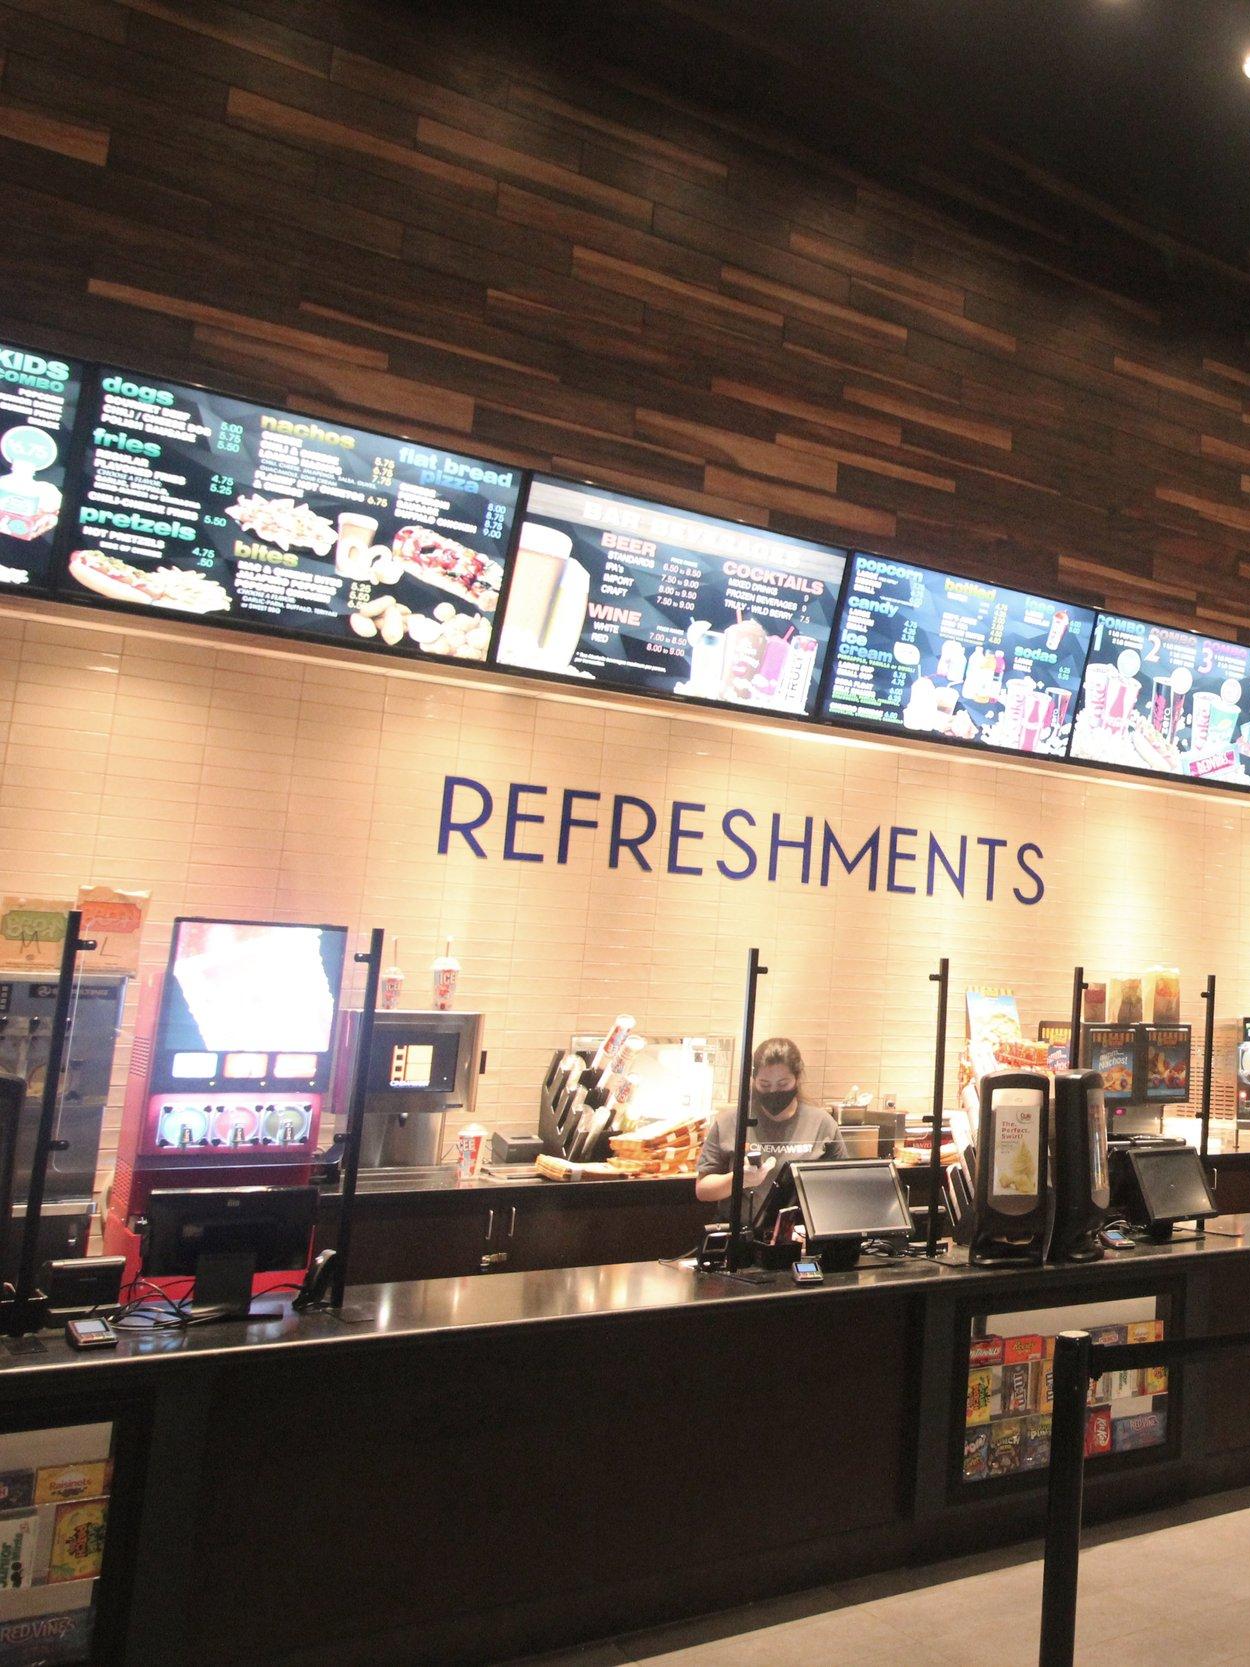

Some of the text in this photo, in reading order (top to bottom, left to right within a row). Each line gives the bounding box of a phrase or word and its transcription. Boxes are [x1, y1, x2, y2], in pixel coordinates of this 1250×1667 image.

[0, 349, 69, 381] KIDS
[102, 376, 174, 405] dogs
[260, 415, 356, 449] nachos
[93, 427, 161, 457] fries
[399, 446, 513, 488] flat bread
[210, 484, 232, 495] 5.25
[211, 475, 234, 486] 4.75
[419, 469, 480, 494] pizza
[367, 496, 388, 507] 6.75
[487, 503, 507, 515] 8.00
[79, 506, 196, 541] pretzels
[204, 515, 227, 527] 5.50
[485, 511, 505, 523] 8.75
[582, 500, 641, 530] BAR
[482, 528, 501, 539] 9.00
[484, 520, 503, 531] 8.75
[192, 547, 215, 559] 4.75
[234, 540, 299, 567] bites
[601, 531, 657, 558] BEER
[605, 562, 625, 574] IPA's
[607, 550, 656, 569] STANDARDS
[662, 563, 679, 573] 6.50
[685, 568, 702, 578] 8.50
[722, 560, 825, 595] COCKTAILS
[855, 557, 924, 583] popcorn
[603, 573, 635, 587] IMPORT
[661, 574, 677, 584] 7.50
[683, 579, 700, 589] 9.00
[728, 577, 779, 596] MIXED DRINKS
[600, 584, 628, 597] CRAFT
[658, 585, 675, 595] 8.00
[681, 590, 697, 600] 9.50
[725, 588, 798, 611] FROZEN BEVERAGES
[656, 596, 672, 606] 7.50
[679, 600, 695, 611] 9.00
[724, 598, 794, 621] TRULY WILD BERRY
[848, 596, 899, 617] candy
[588, 602, 642, 627] WINE
[593, 621, 620, 634] WHITE
[1097, 614, 1146, 635] COMBO
[590, 632, 609, 643] RED
[649, 632, 665, 642] 7.00
[671, 636, 688, 646] 8.50
[841, 629, 868, 647] ice
[1094, 623, 1104, 651] 1
[1150, 627, 1198, 646] COMBO
[646, 643, 662, 653] 8.00
[669, 647, 685, 657] 9.00
[839, 643, 893, 663] cream
[1014, 646, 1058, 664] sodas
[1144, 634, 1162, 663] 2
[1203, 640, 1249, 658] COMBO
[1197, 647, 1214, 674] 3
[437, 775, 1045, 906] REFRESHMENTS
[20, 930, 41, 954] M
[749, 1142, 814, 1154] CINEMAWEST
